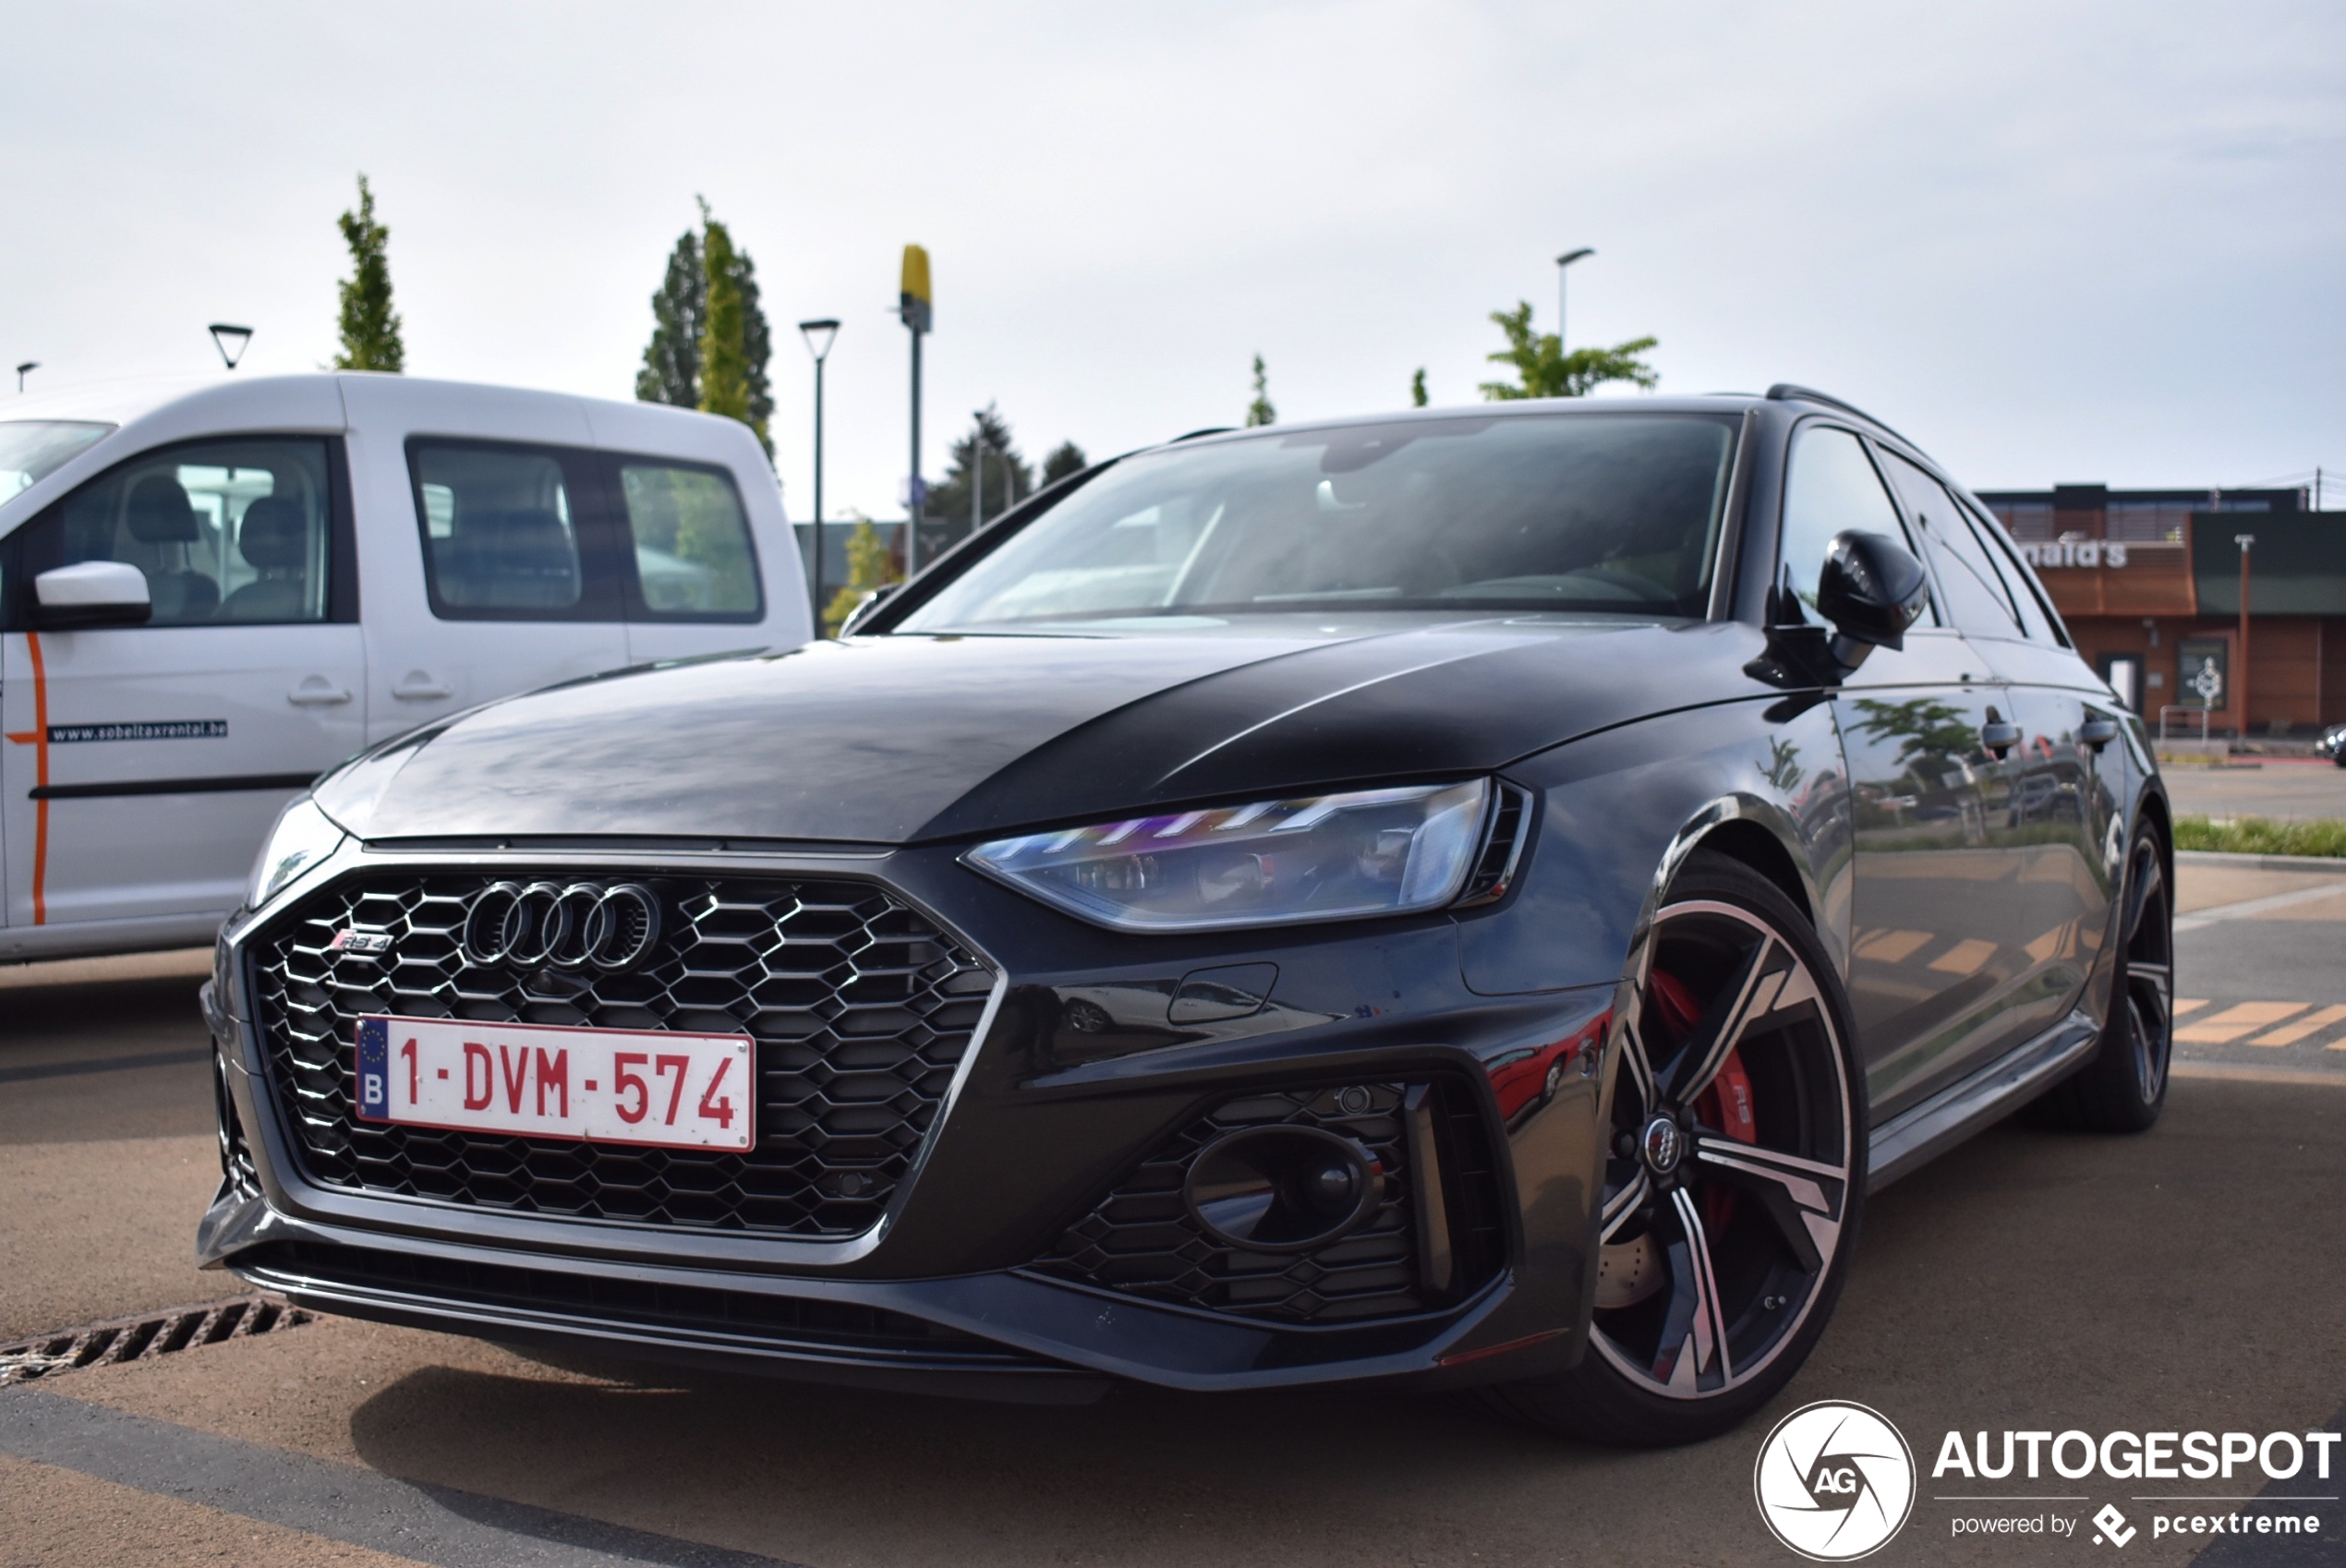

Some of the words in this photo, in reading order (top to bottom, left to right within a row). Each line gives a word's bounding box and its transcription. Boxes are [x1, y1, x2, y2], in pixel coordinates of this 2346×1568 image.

[364, 1074, 383, 1104] B
[400, 1038, 735, 1128] 1-DVM-574
[1734, 1085, 1751, 1124] RS
